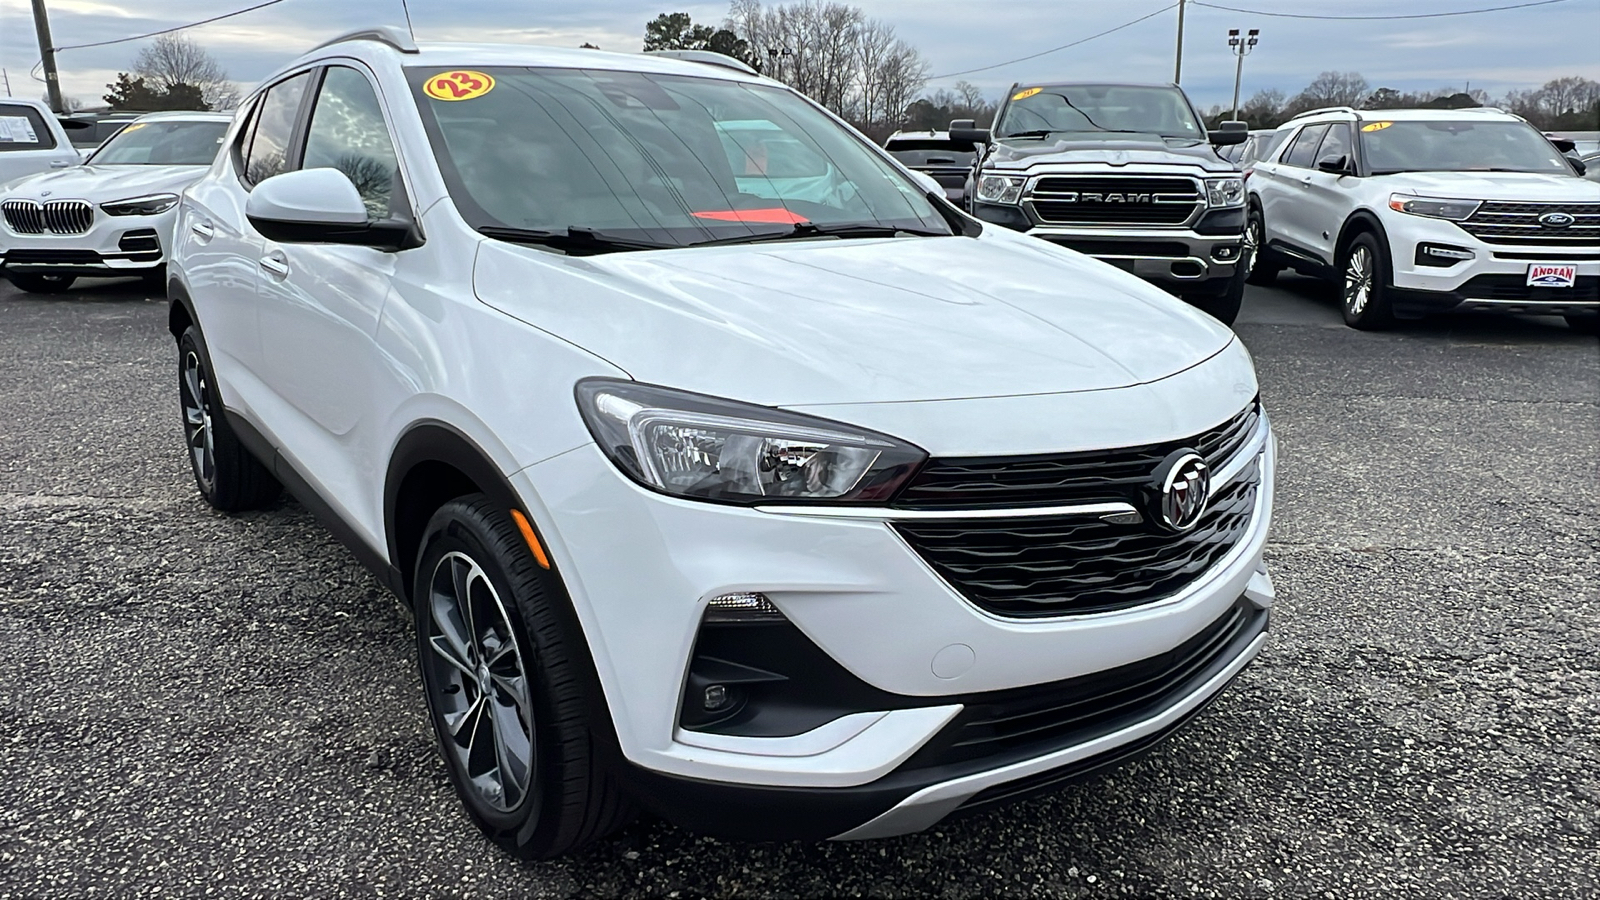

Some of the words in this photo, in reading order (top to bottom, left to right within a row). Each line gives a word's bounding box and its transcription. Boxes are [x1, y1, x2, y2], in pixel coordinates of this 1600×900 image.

[437, 72, 482, 98] 23
[1081, 193, 1150, 203] RAM
[1547, 215, 1568, 223] Ford
[1531, 267, 1574, 280] ANDEAN
